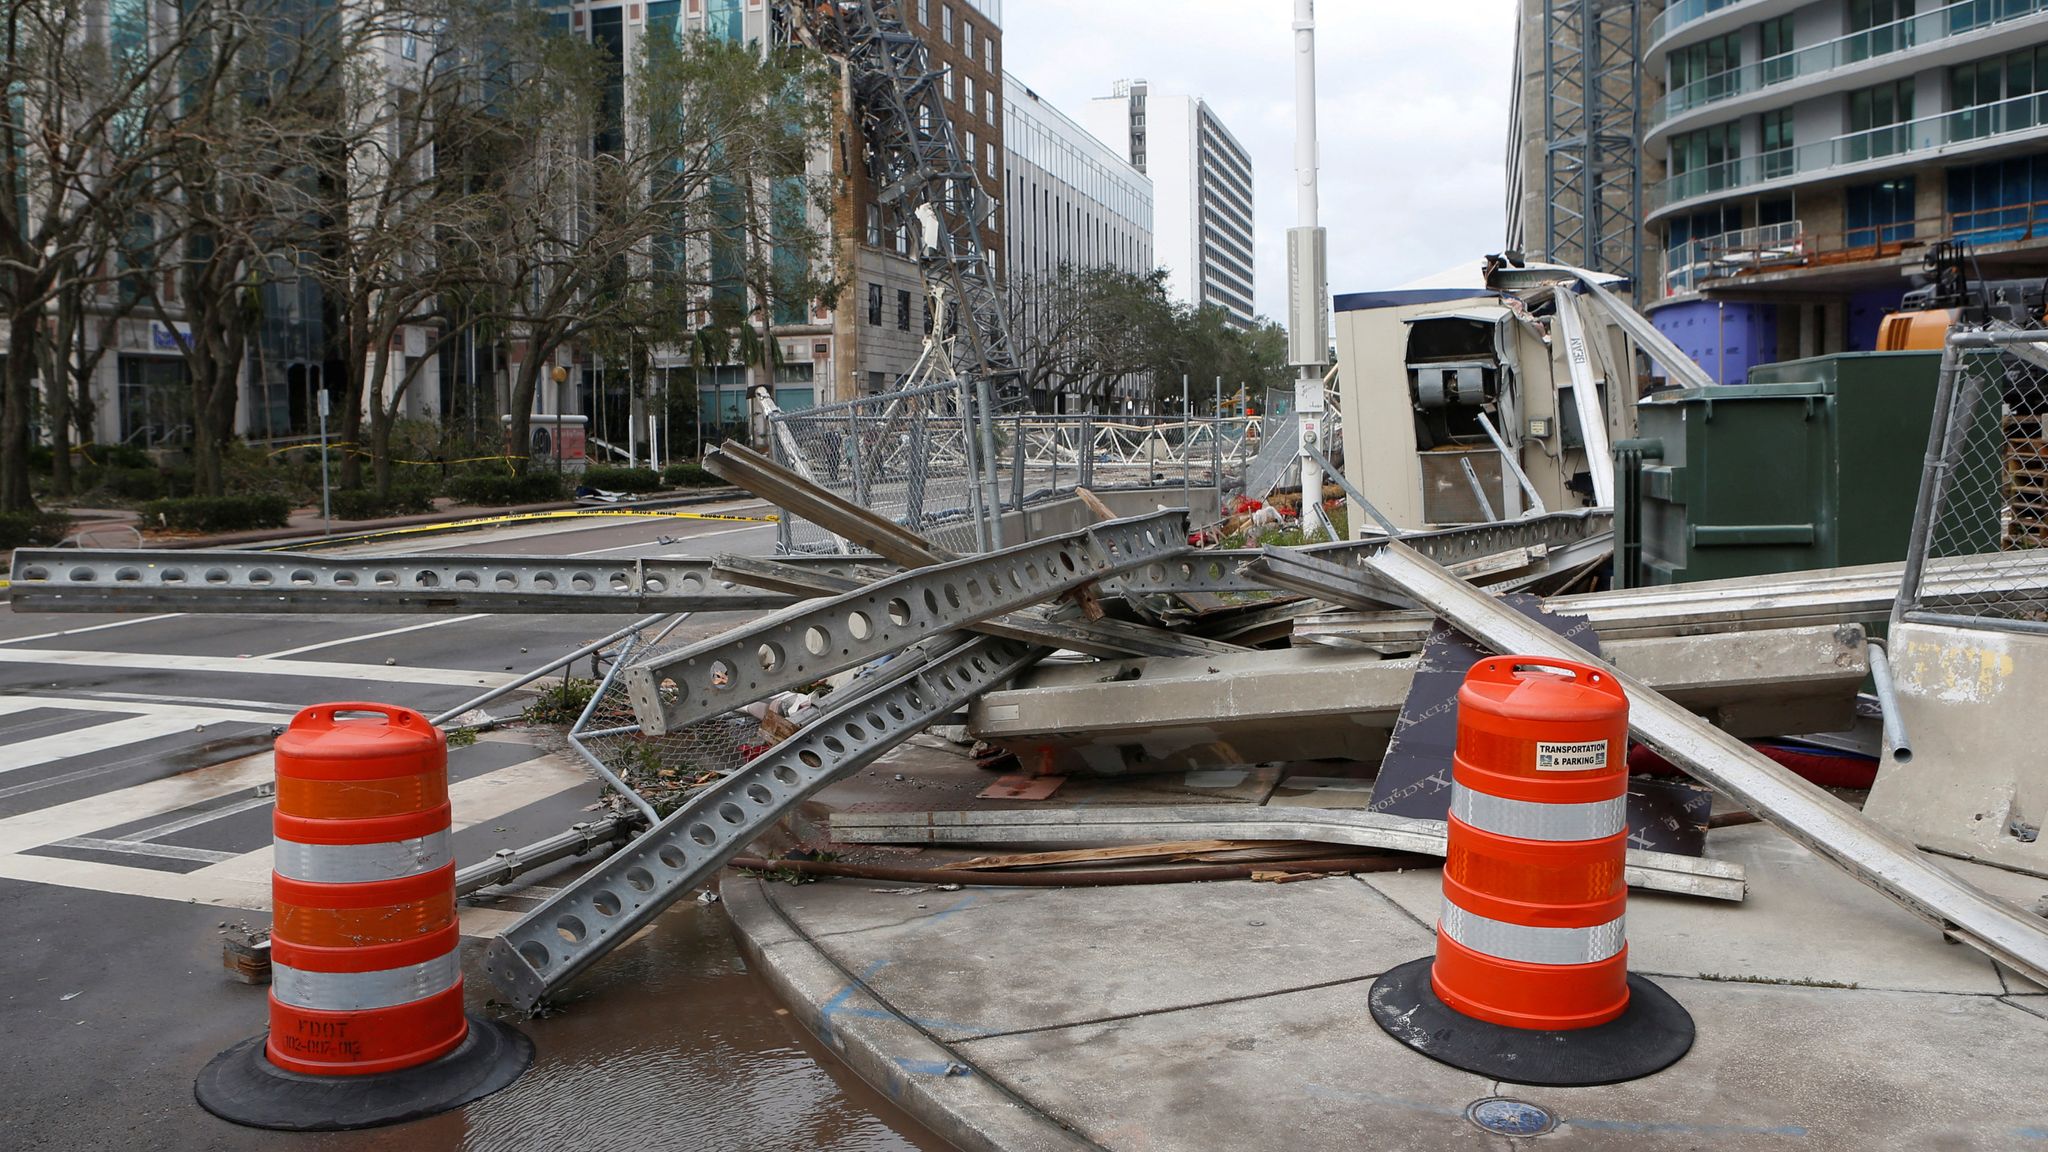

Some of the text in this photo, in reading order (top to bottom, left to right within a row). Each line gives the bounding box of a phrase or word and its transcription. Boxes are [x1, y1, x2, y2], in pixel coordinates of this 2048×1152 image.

[1540, 743, 1606, 754] TRANSPORTATION
[1553, 757, 1560, 766] &
[1562, 756, 1595, 765] PARKING
[298, 1019, 348, 1038] FDOT
